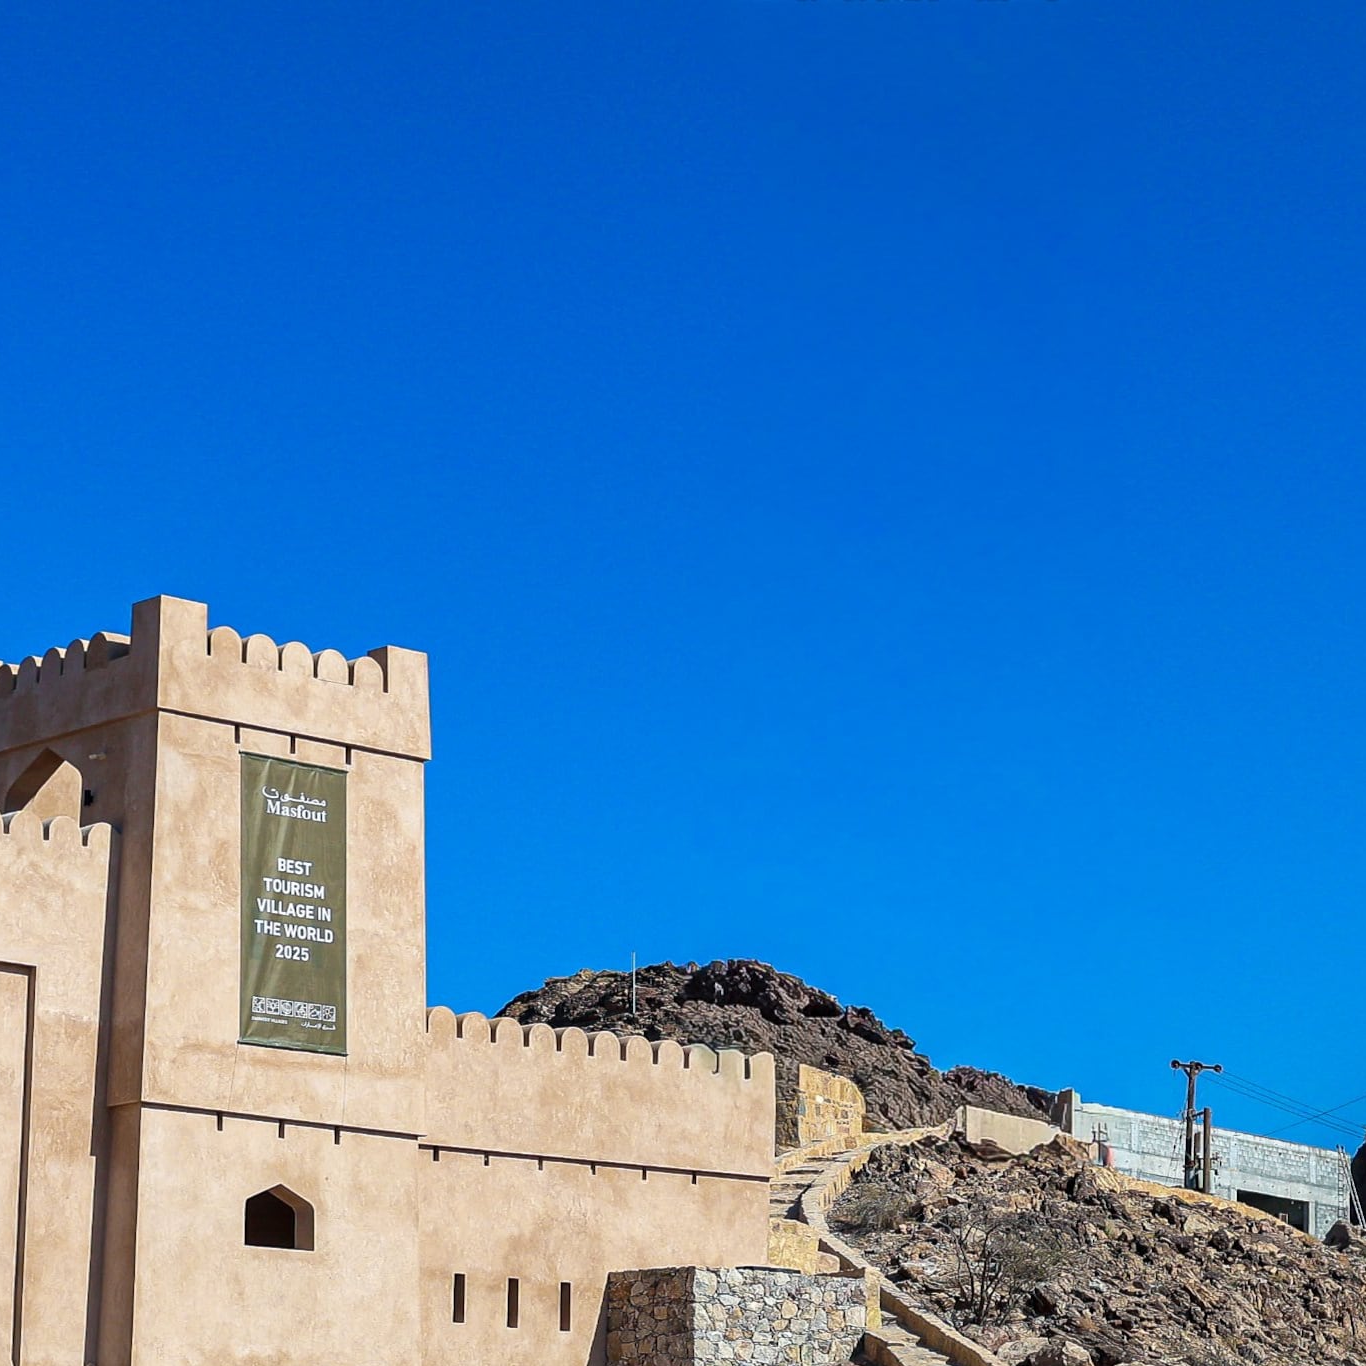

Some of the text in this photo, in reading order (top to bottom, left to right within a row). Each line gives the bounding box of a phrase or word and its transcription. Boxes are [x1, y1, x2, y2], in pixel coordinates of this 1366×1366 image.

[266, 799, 327, 822] Masfout
[278, 857, 312, 876] BEST
[263, 877, 325, 899] TOURISM
[257, 898, 331, 922] VILLAGE IN
[254, 919, 334, 943] THE WORLD
[275, 944, 309, 961] 2025
